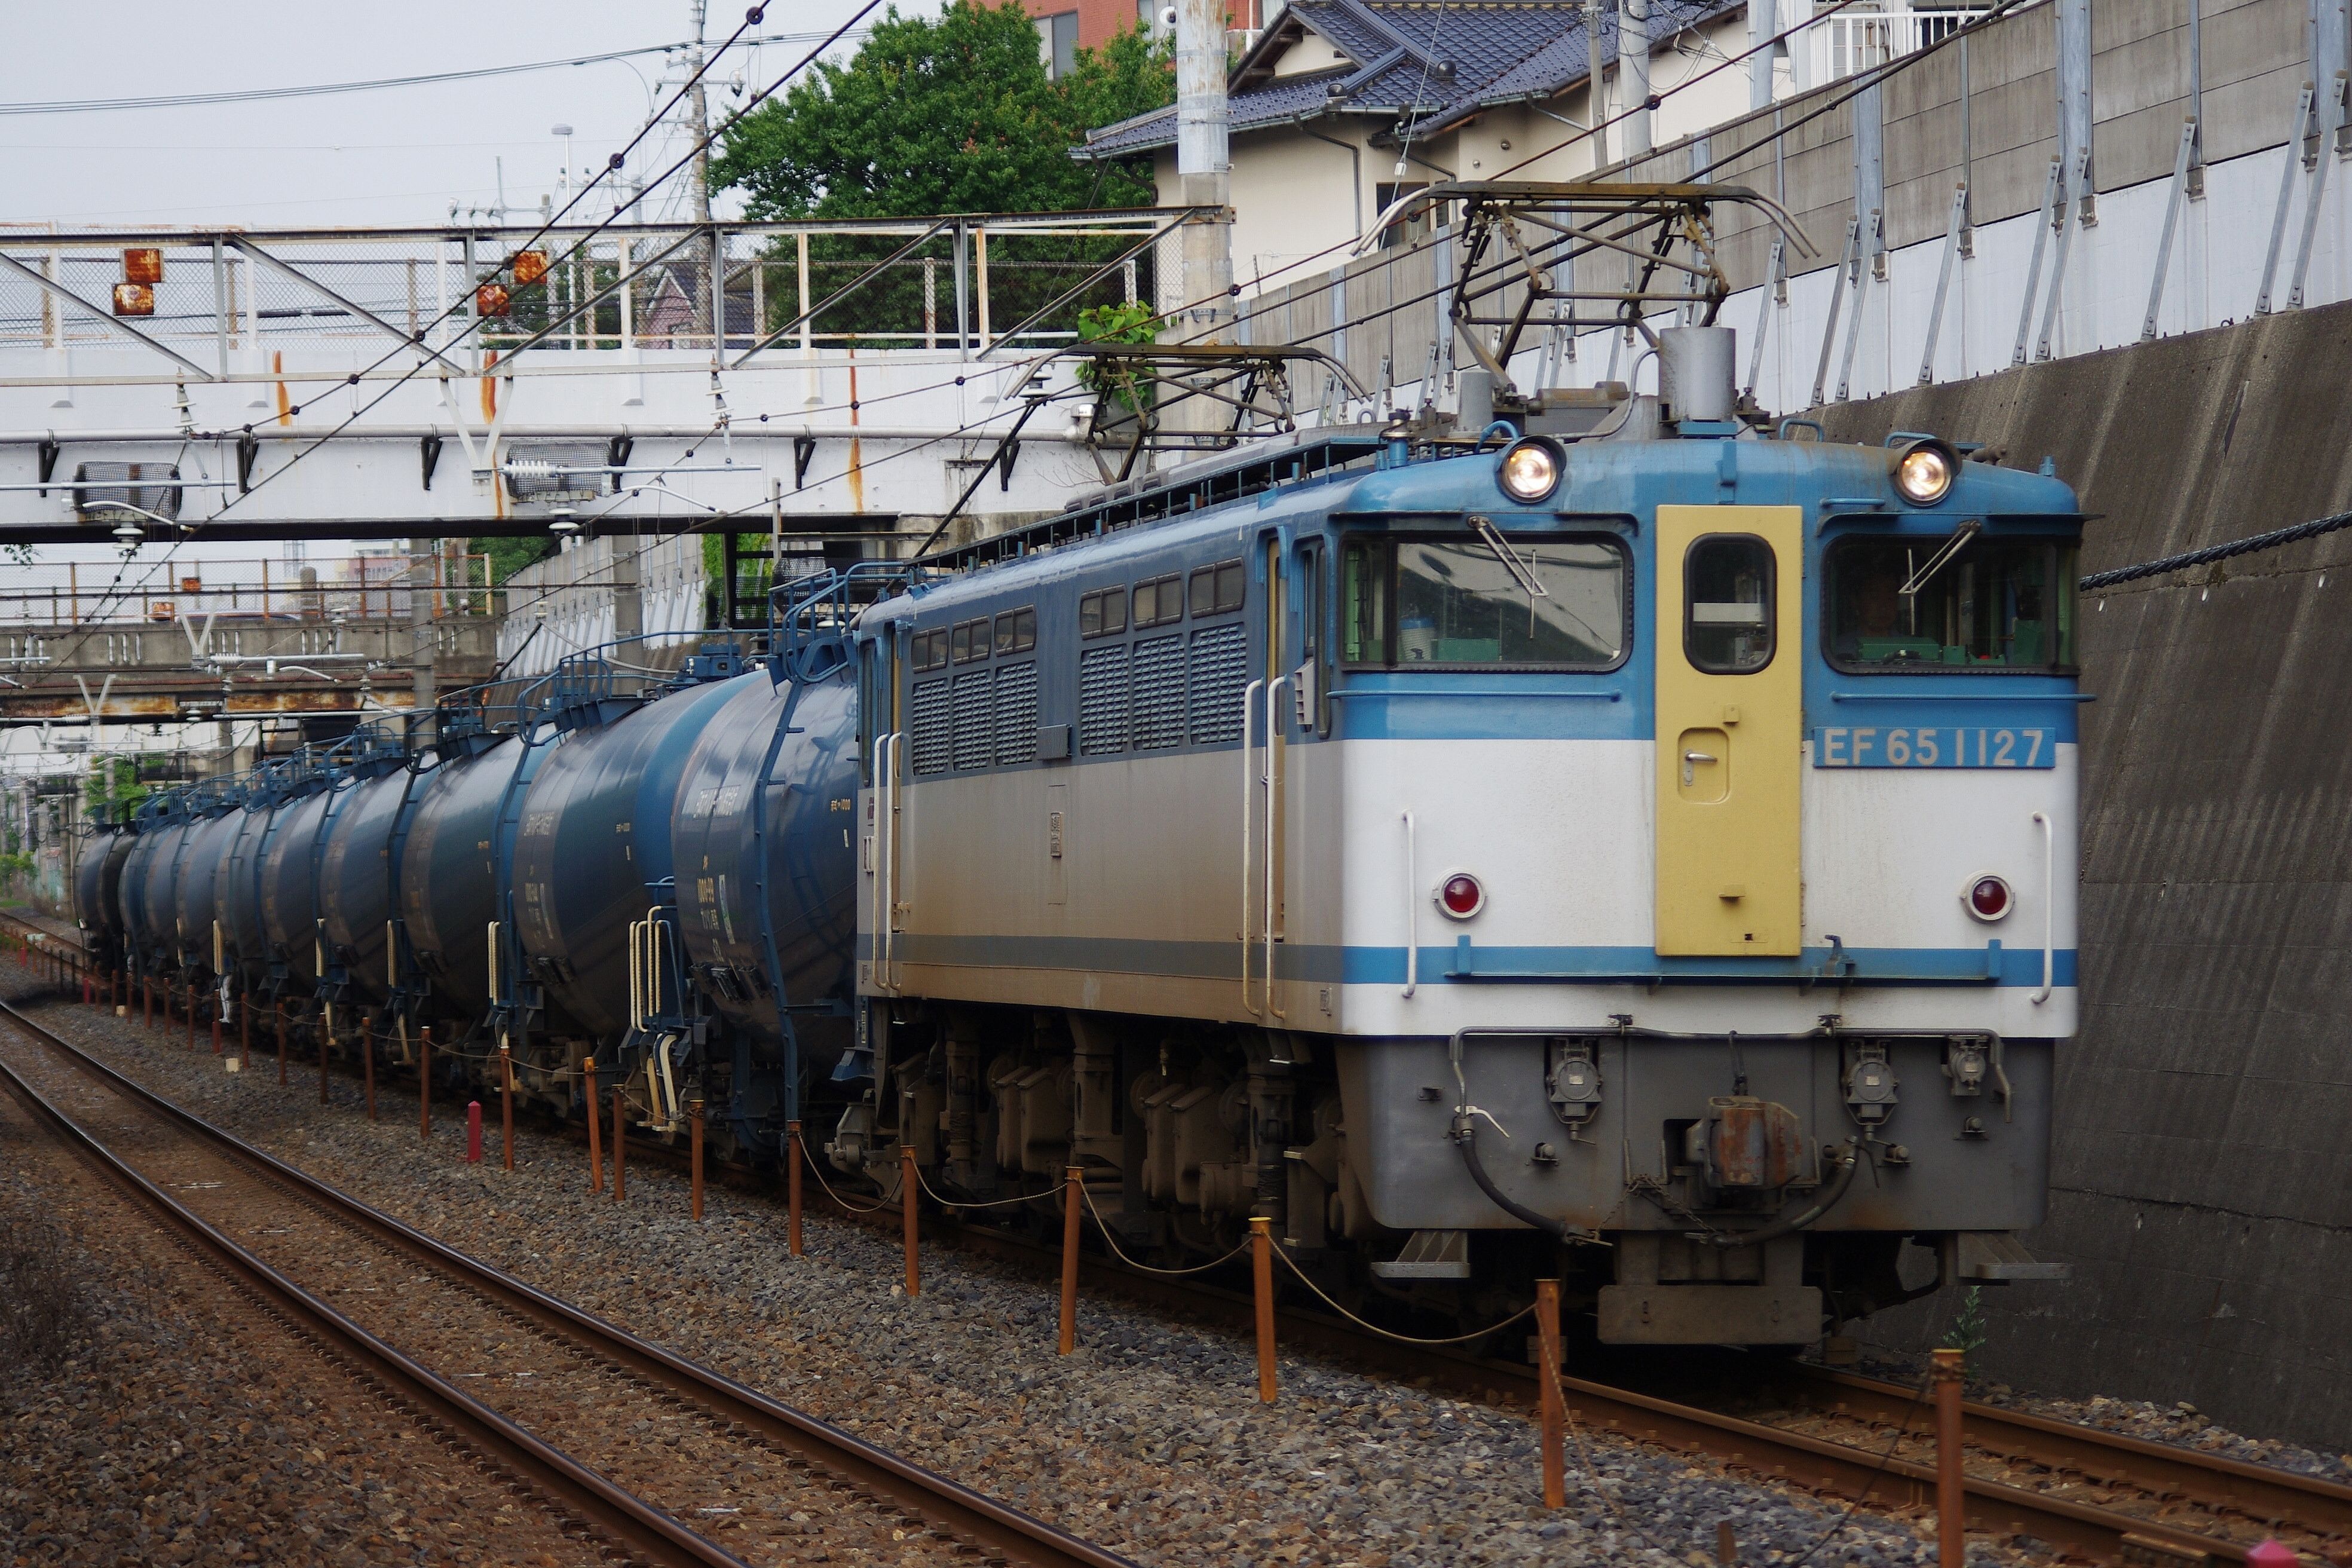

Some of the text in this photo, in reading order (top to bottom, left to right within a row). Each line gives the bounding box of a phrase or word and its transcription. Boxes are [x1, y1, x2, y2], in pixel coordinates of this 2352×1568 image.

[1824, 728, 2044, 766] EF 65 1127
